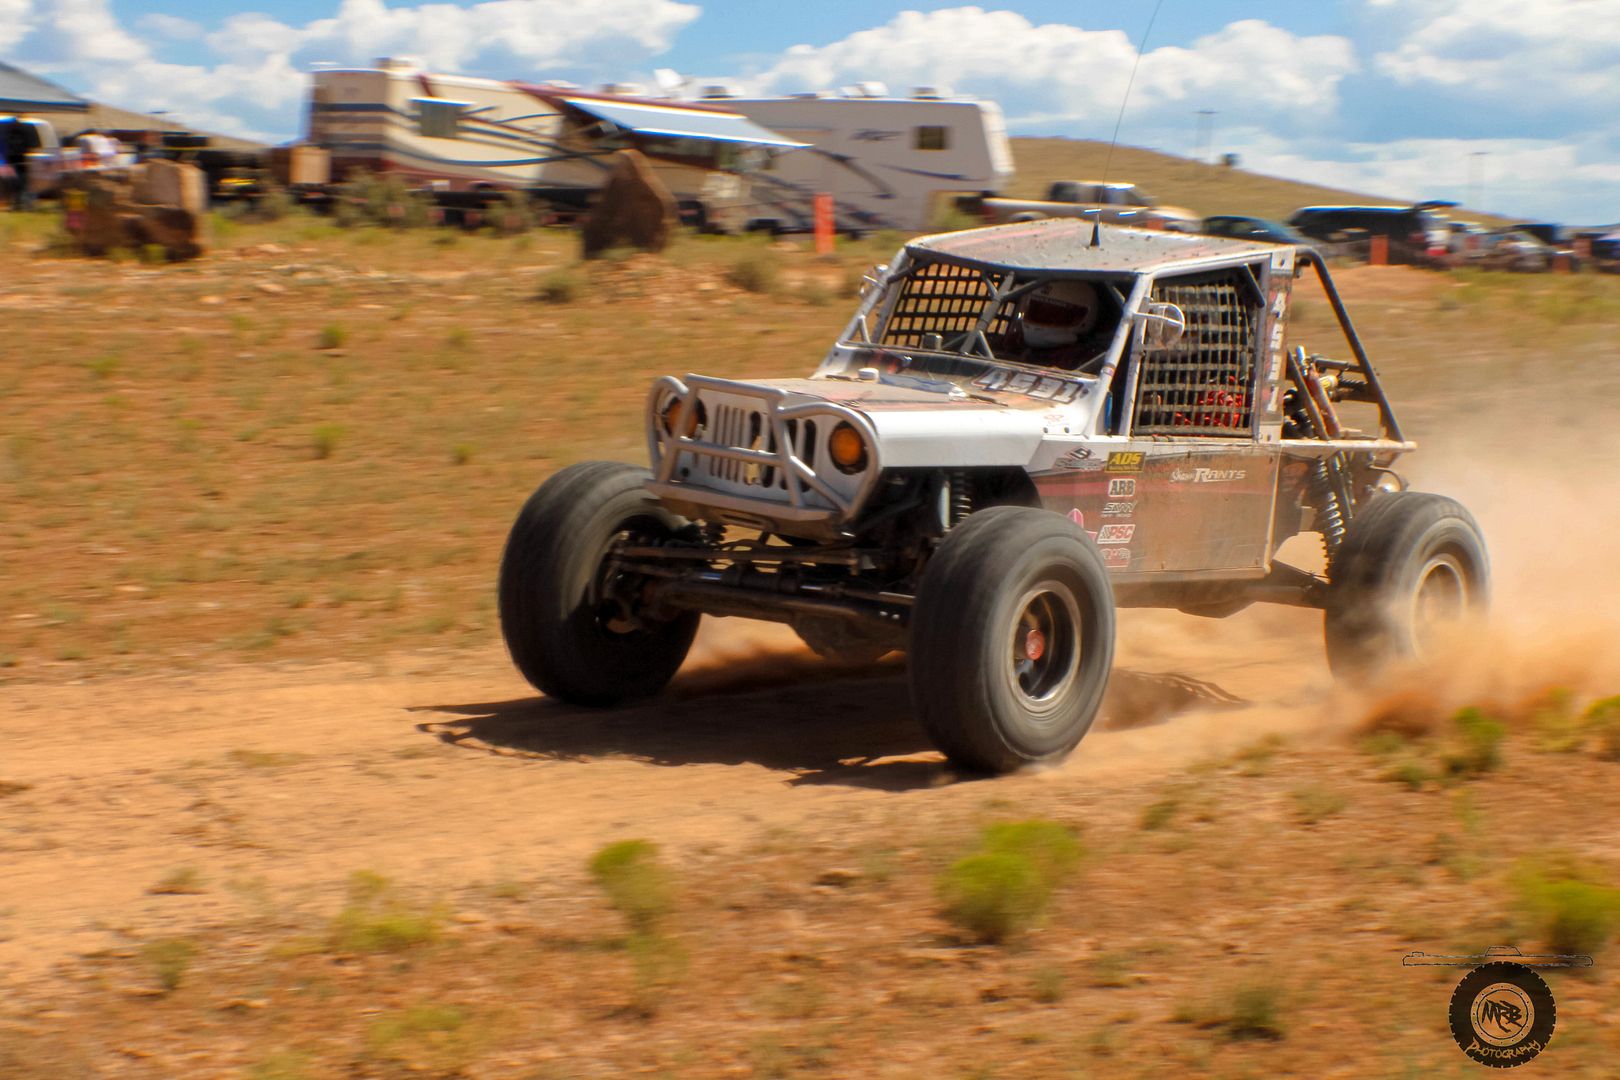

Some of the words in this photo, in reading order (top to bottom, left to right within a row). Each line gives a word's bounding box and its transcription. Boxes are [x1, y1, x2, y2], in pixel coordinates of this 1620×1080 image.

[1110, 453, 1142, 465] ADS
[1110, 480, 1134, 496] ARB
[1110, 525, 1134, 539] PSC
